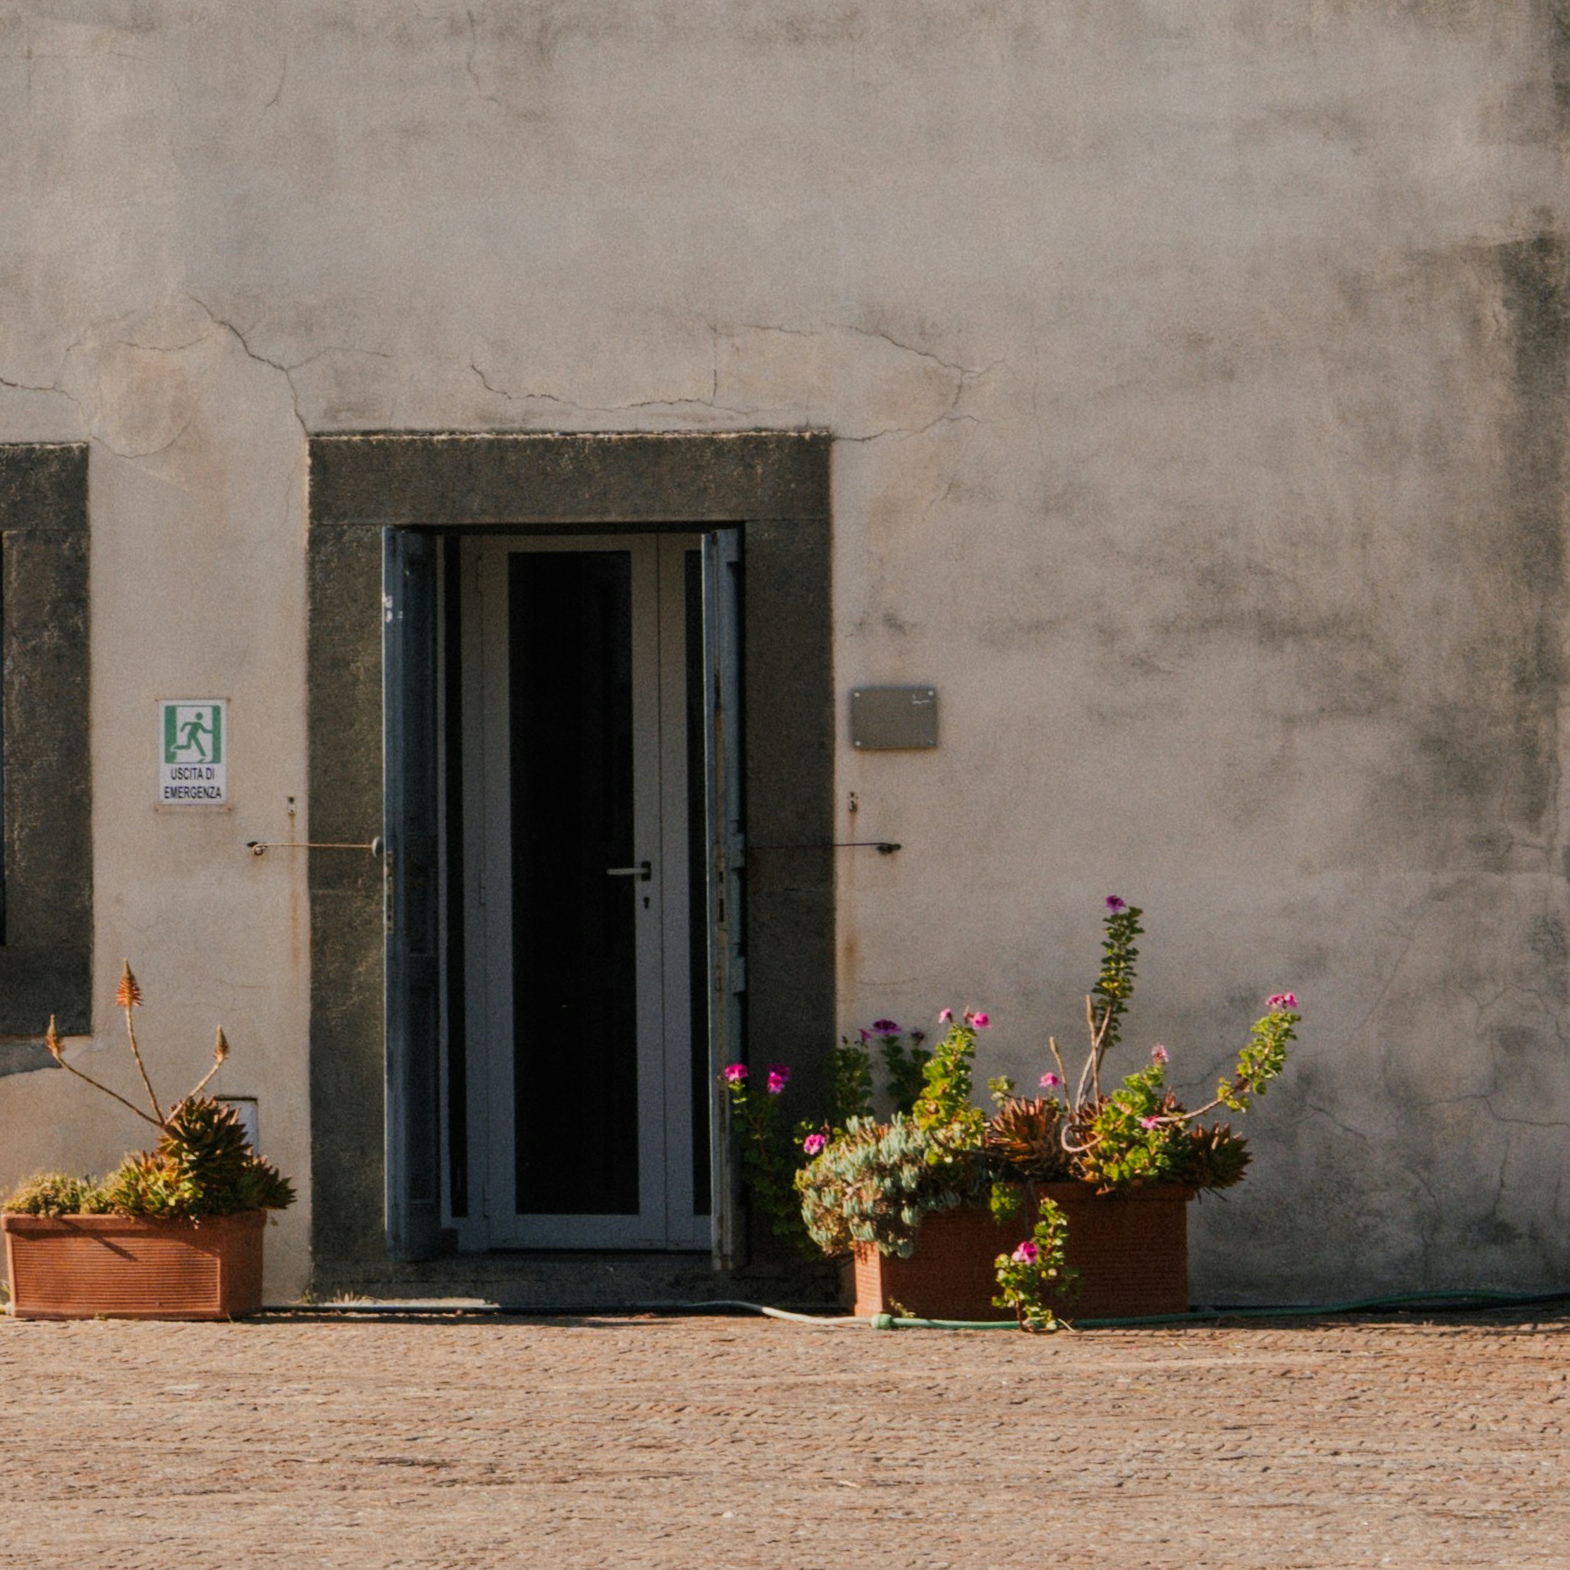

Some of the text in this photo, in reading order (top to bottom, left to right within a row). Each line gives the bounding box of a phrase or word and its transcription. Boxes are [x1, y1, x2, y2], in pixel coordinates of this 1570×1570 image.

[171, 767, 215, 780] USCITA DI
[164, 785, 222, 799] EMERGENZA
